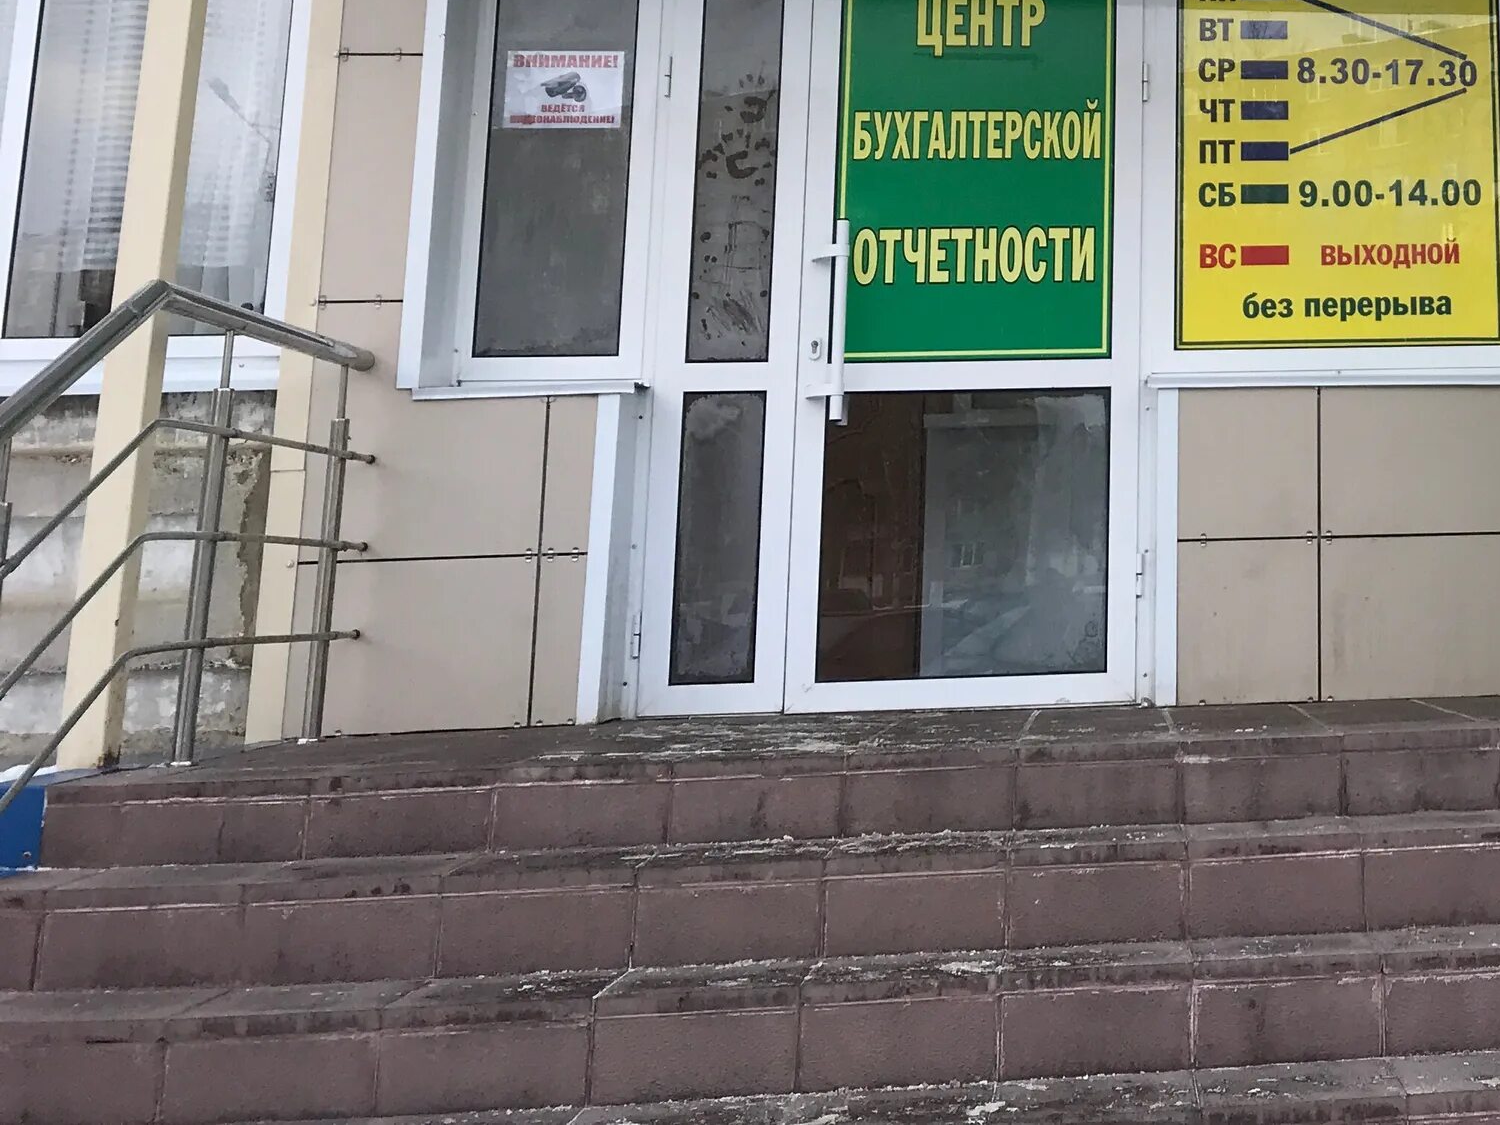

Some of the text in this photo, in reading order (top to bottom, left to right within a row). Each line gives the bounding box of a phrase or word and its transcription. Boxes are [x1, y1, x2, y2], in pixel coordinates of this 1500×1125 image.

[1199, 18, 1235, 42] ВТ
[513, 54, 619, 69] ВНИМАНИЕ!
[1198, 57, 1478, 88] СР 8.30-17.30
[510, 115, 615, 125] ЕОНАБЛЮДЕНИЕ!
[1199, 98, 1236, 123] ЧТ
[852, 98, 1102, 161] БУХГАЛТЕРСКОЙ
[1199, 139, 1236, 164] ПТ
[1198, 178, 1482, 208] СБ 9.00-14.00
[852, 226, 1096, 286] ОТЧЕТНОСТИ
[1199, 237, 1460, 269] ВС ВЫХОДНОЙ
[1242, 292, 1452, 322] без перерыва
